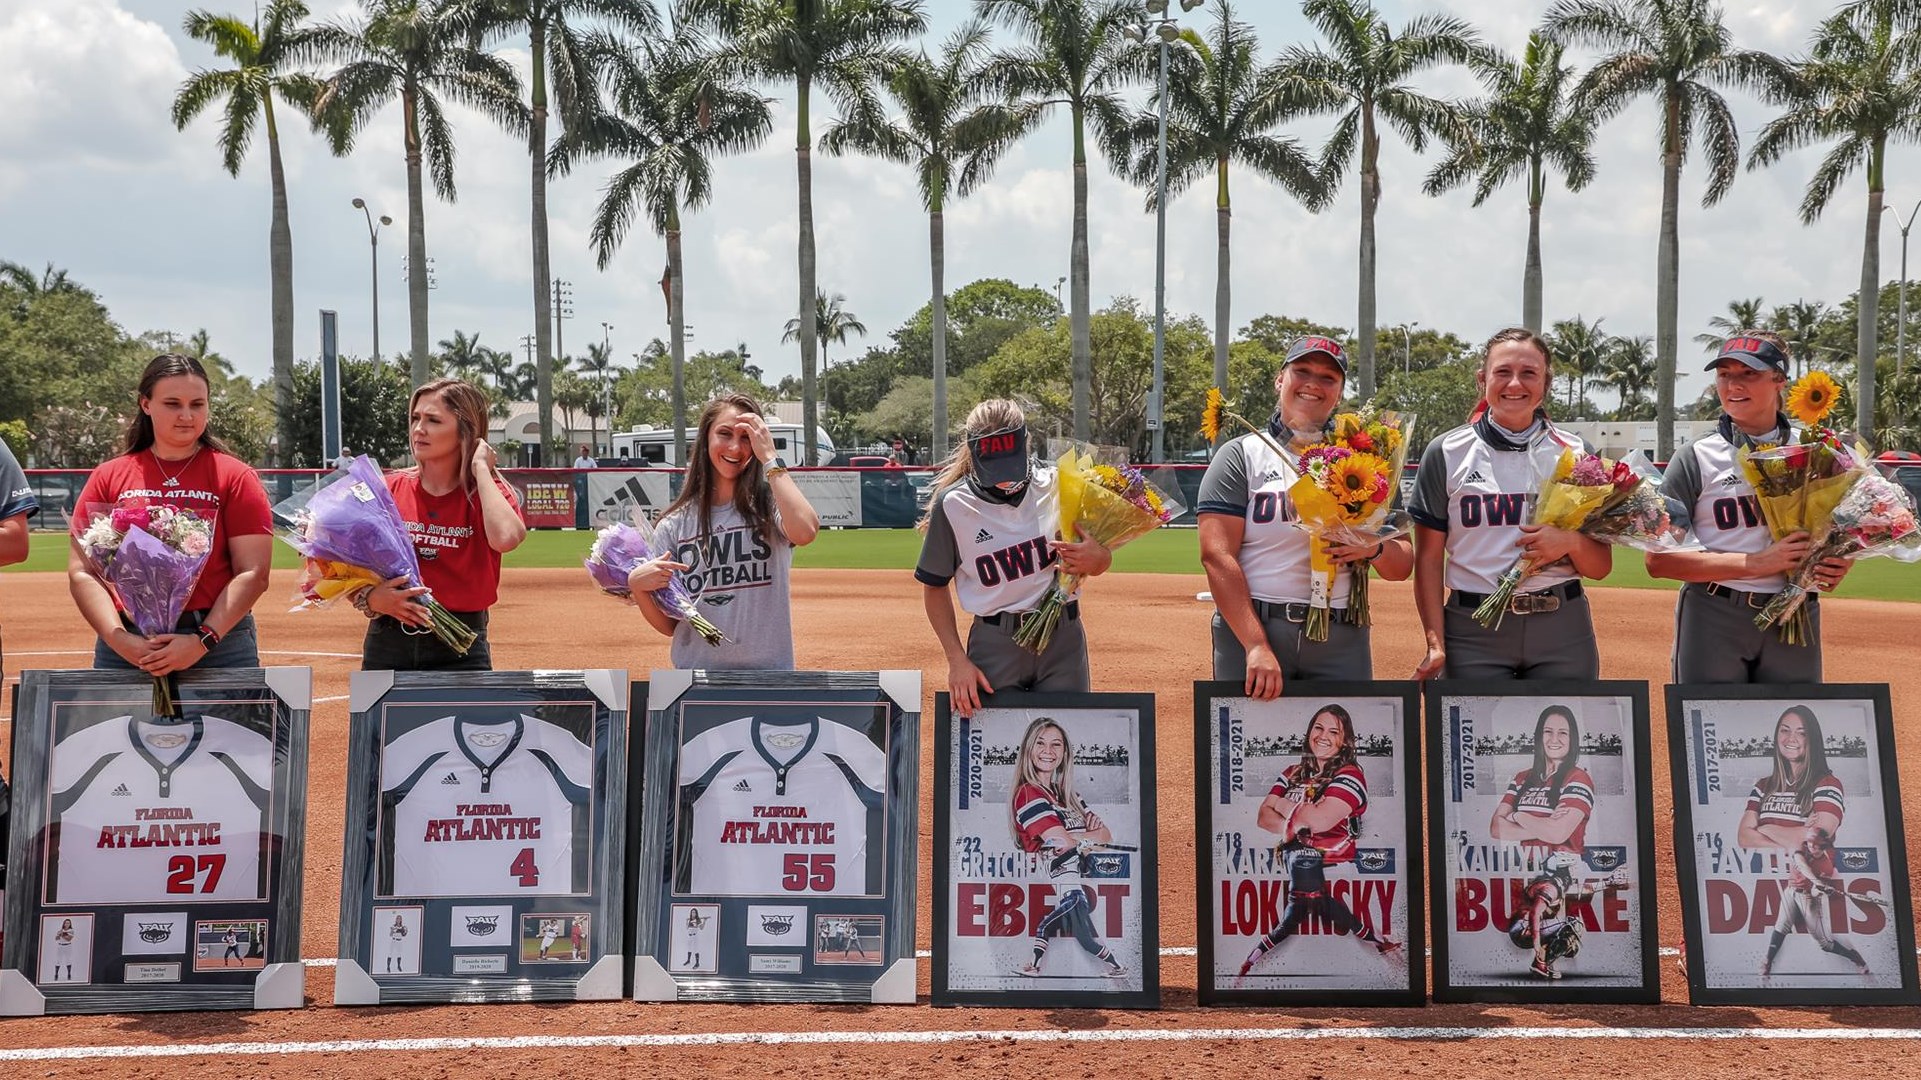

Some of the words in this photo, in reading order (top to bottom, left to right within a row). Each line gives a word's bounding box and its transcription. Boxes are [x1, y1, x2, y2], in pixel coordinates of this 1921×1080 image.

[1304, 337, 1342, 356] FAU
[1723, 338, 1761, 353] FAU
[980, 433, 1015, 455] FAU
[118, 488, 162, 501] ORIDA
[165, 488, 220, 506] ATLANT
[527, 500, 553, 510] LOCAL
[409, 533, 460, 548] OFTBALL
[678, 530, 772, 575] OWLS
[975, 535, 1058, 588] OWL
[682, 562, 772, 594] OFTBALL
[970, 729, 983, 799] 2020-2021
[1231, 718, 1244, 792] 2018-2021
[1462, 718, 1475, 789] 2017-2021
[1704, 722, 1721, 792] 2017-2021
[135, 808, 193, 820] FLORIDA
[456, 804, 512, 815] FLORIDA
[753, 806, 807, 818] FLORIDA
[97, 823, 221, 848] ATLANTIC
[424, 817, 541, 842] ATLANTIC
[720, 821, 835, 844] ATLANTIC
[1216, 832, 1242, 850] #18
[1696, 832, 1723, 849] #16
[955, 836, 981, 852] #22
[510, 848, 539, 887] 4
[1457, 846, 1549, 872] KAITLYN
[166, 854, 226, 893] 27
[782, 854, 836, 891] 55
[1455, 878, 1630, 932] BUKE
